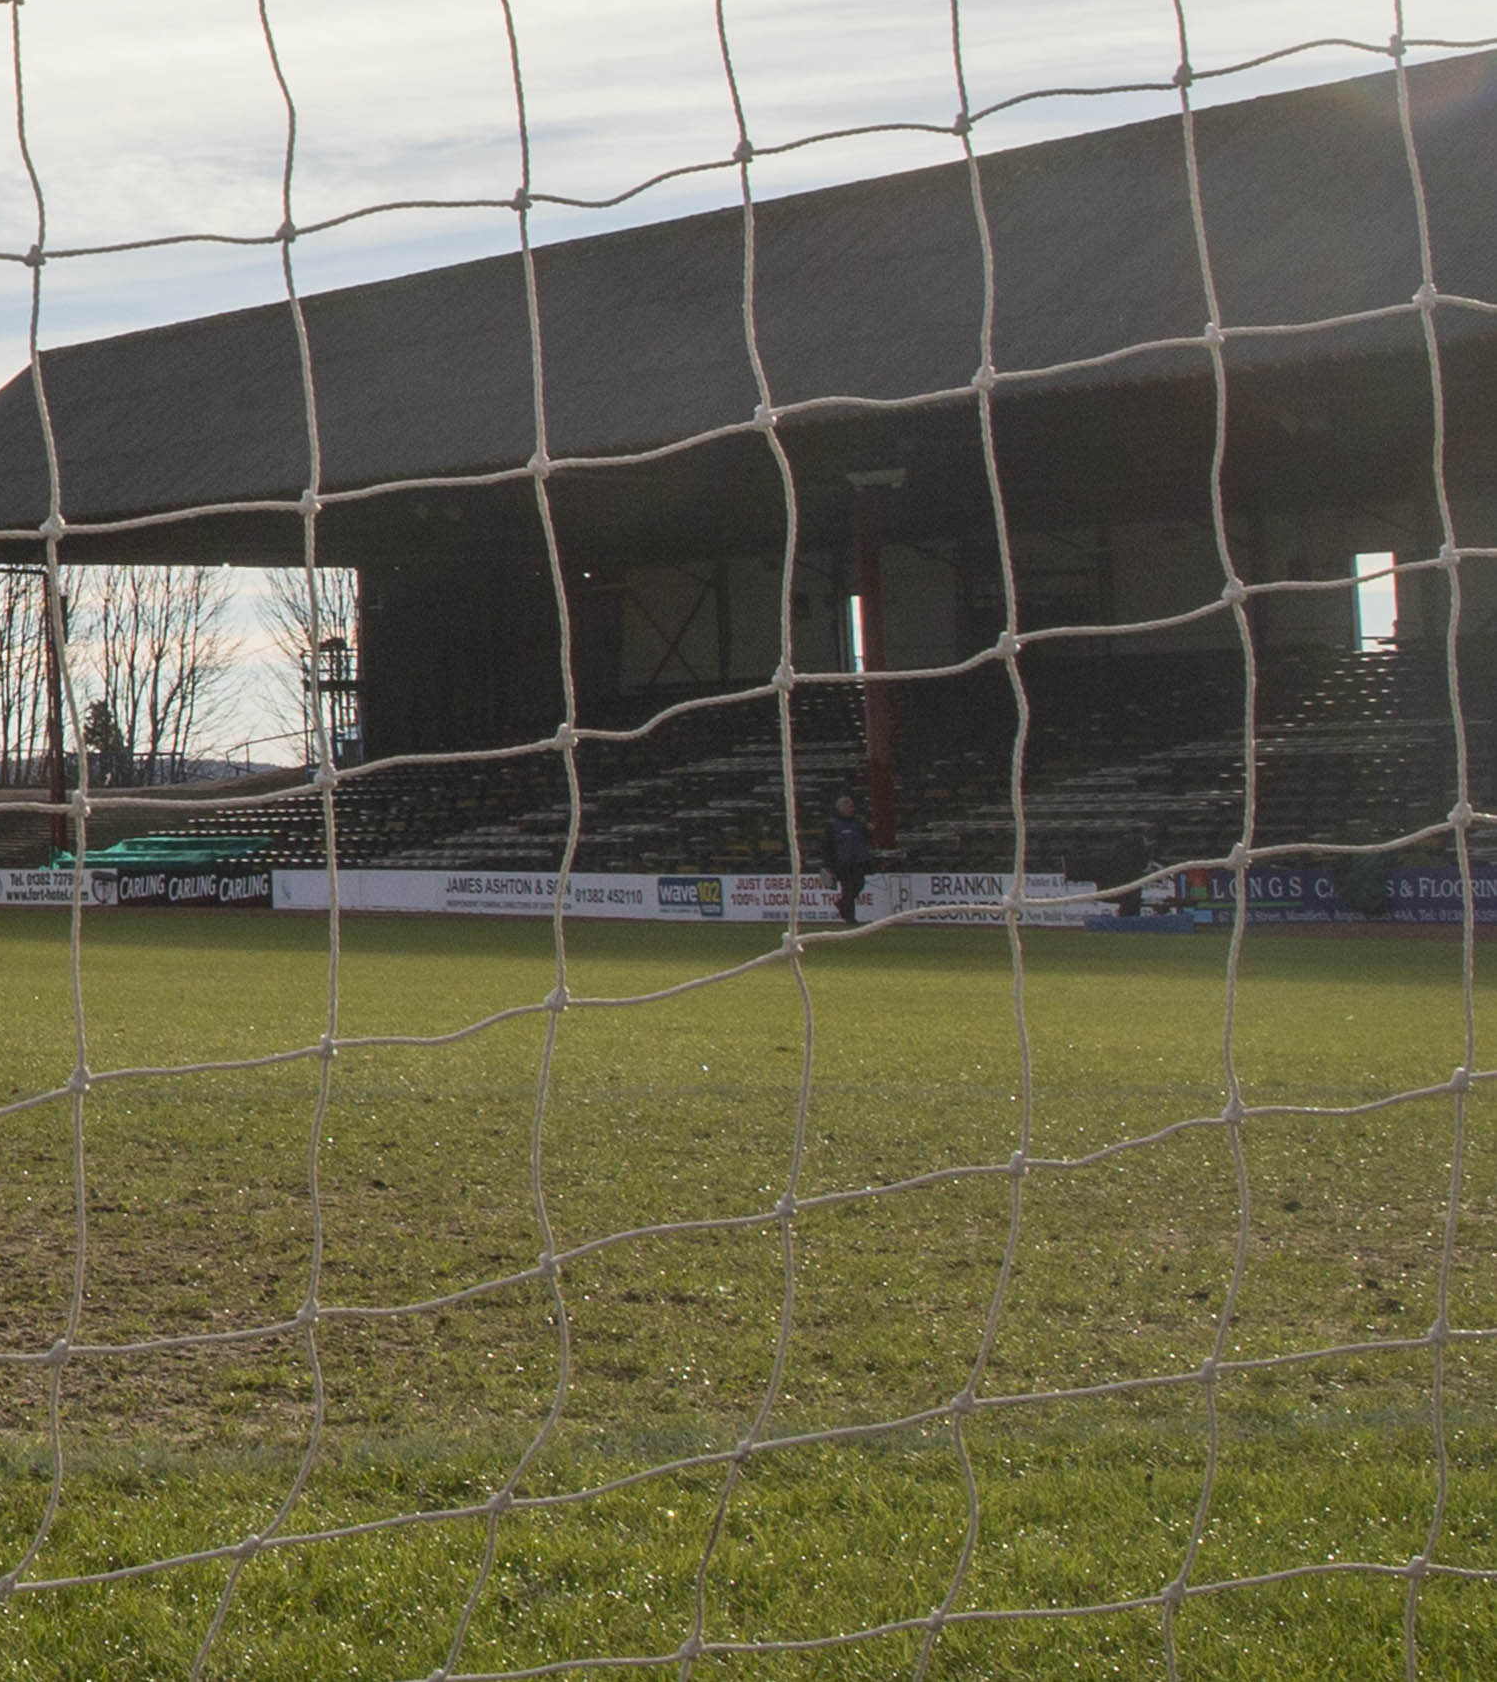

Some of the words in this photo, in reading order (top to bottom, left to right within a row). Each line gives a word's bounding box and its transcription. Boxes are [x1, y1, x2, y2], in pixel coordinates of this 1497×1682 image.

[119, 874, 166, 900] CARLING
[169, 874, 217, 902] CARLING
[219, 873, 269, 902] CARLING
[446, 878, 483, 894] JAMES
[485, 878, 532, 895] ASHTON
[534, 879, 543, 895] &
[574, 889, 605, 904] 01382
[606, 889, 643, 905] 452110
[659, 881, 721, 904] wave102
[736, 877, 761, 890] JUST
[764, 878, 794, 890] GREA
[931, 875, 1003, 896] BRANKIN
[1211, 876, 1303, 899] LONGS
[1399, 878, 1414, 897] &
[730, 893, 761, 906] 100%
[762, 894, 793, 906] LOCA
[799, 894, 819, 906] ALL
